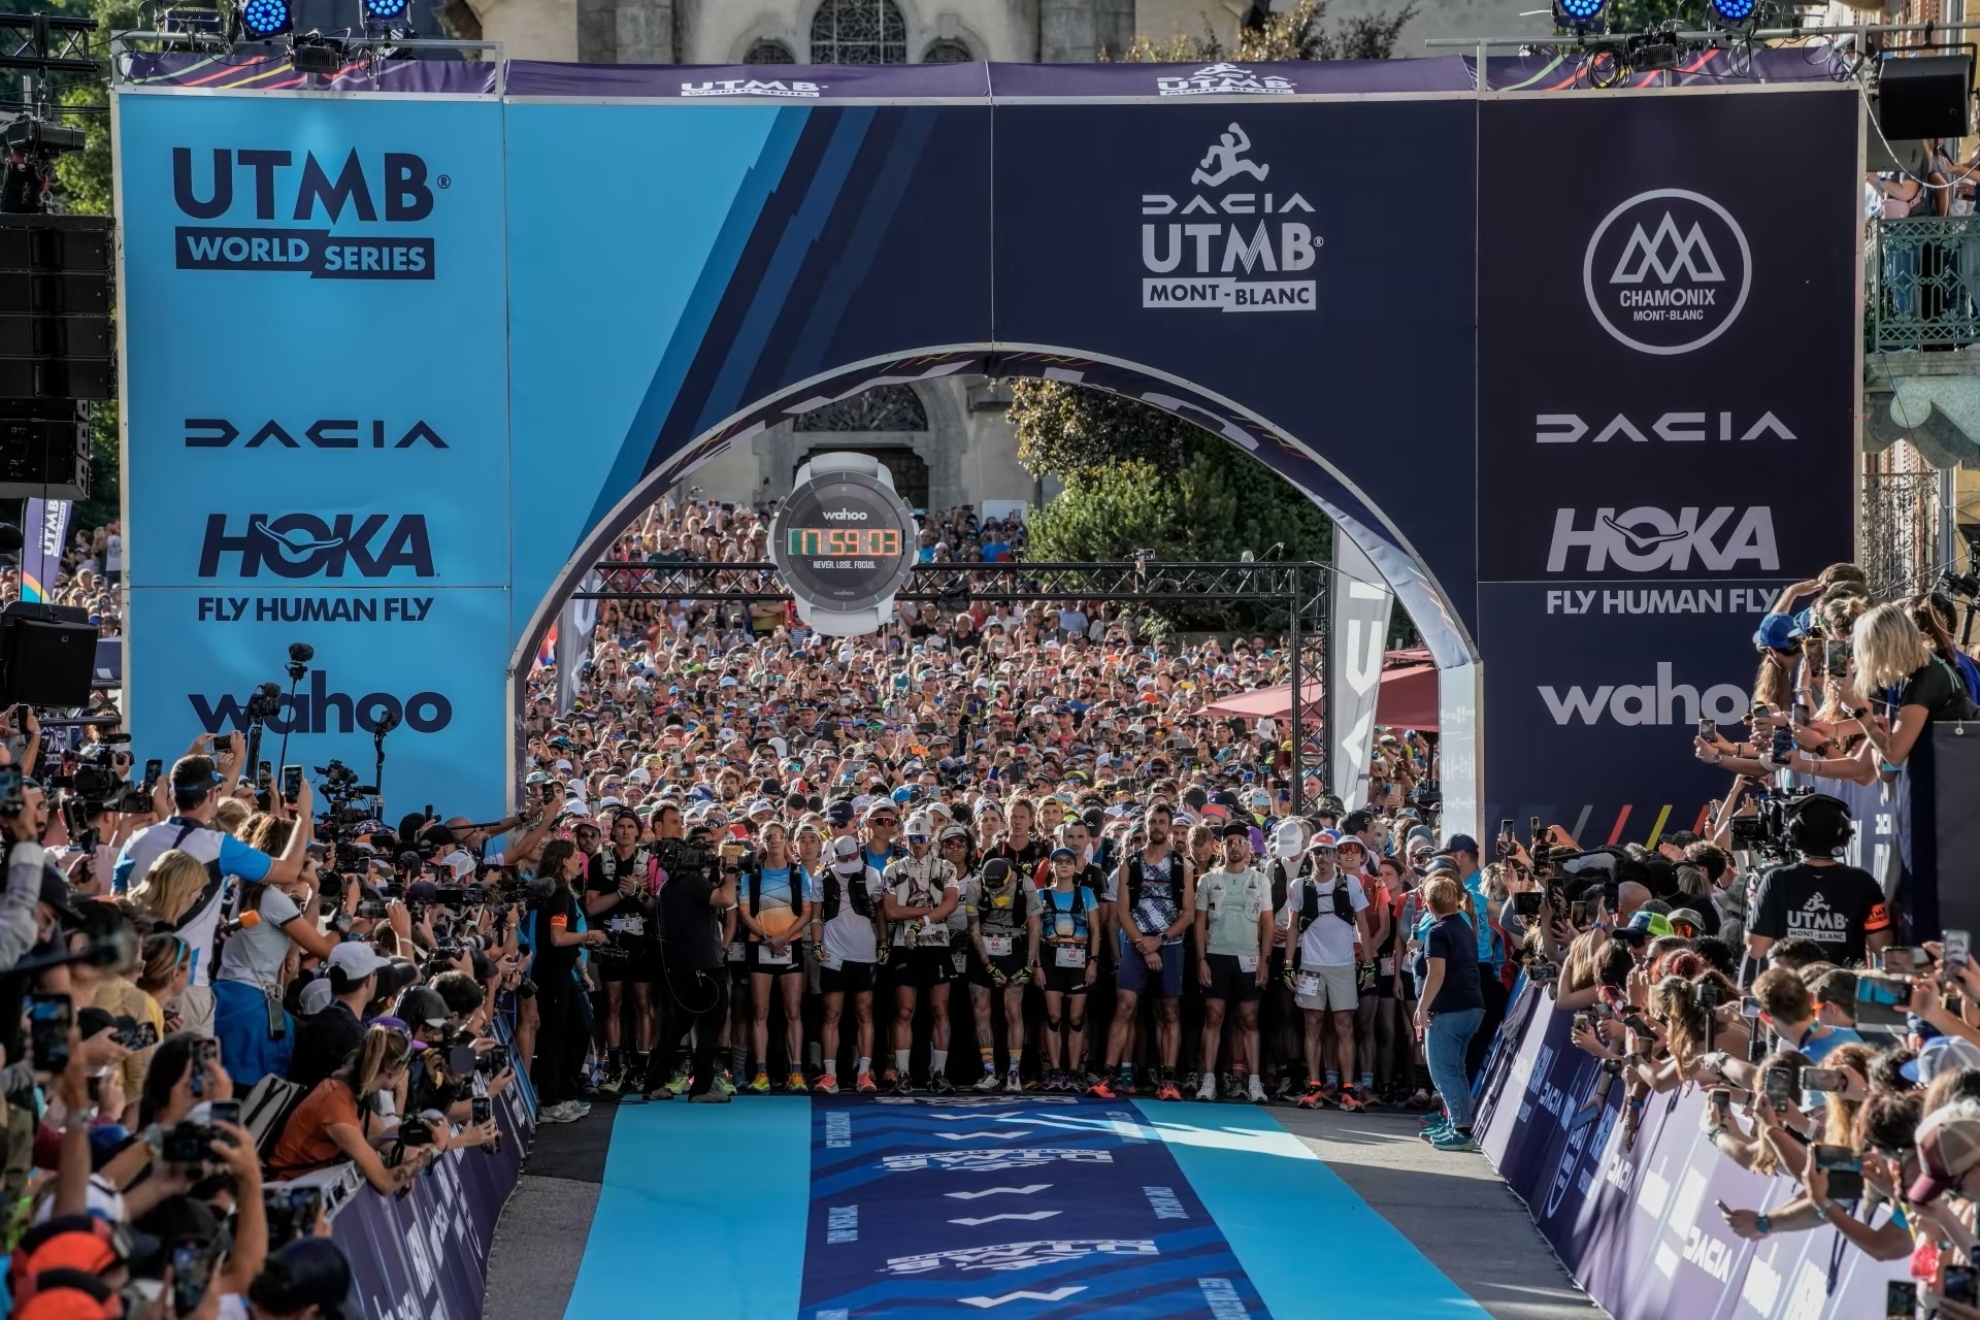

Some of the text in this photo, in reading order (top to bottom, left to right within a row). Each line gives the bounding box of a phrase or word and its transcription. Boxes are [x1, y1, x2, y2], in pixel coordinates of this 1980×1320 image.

[681, 79, 820, 92] UTMB
[1143, 193, 1315, 214] DACIA
[186, 236, 426, 272] WORLD SERIES
[1619, 287, 1716, 308] CHAMONIX
[1633, 310, 1704, 322] MONT-BLANC
[185, 419, 449, 449] DACIA
[1536, 410, 1798, 443] DACIA
[43, 499, 60, 556] UTMB
[823, 508, 868, 521] wahoo
[198, 513, 434, 578] HOKA
[1547, 506, 1780, 572] HOKA
[813, 560, 876, 569] NEVER. LOSE. FOCUS.
[199, 597, 434, 622] FLY HUMAN FLY
[1547, 588, 1781, 614] FLY HUMAN FLY
[187, 669, 453, 735] wahoo
[1537, 661, 1757, 726] waho
[1787, 910, 1847, 930] UTMB
[1790, 931, 1844, 941] MONT-BLANC
[1683, 1225, 1733, 1284] DACIA
